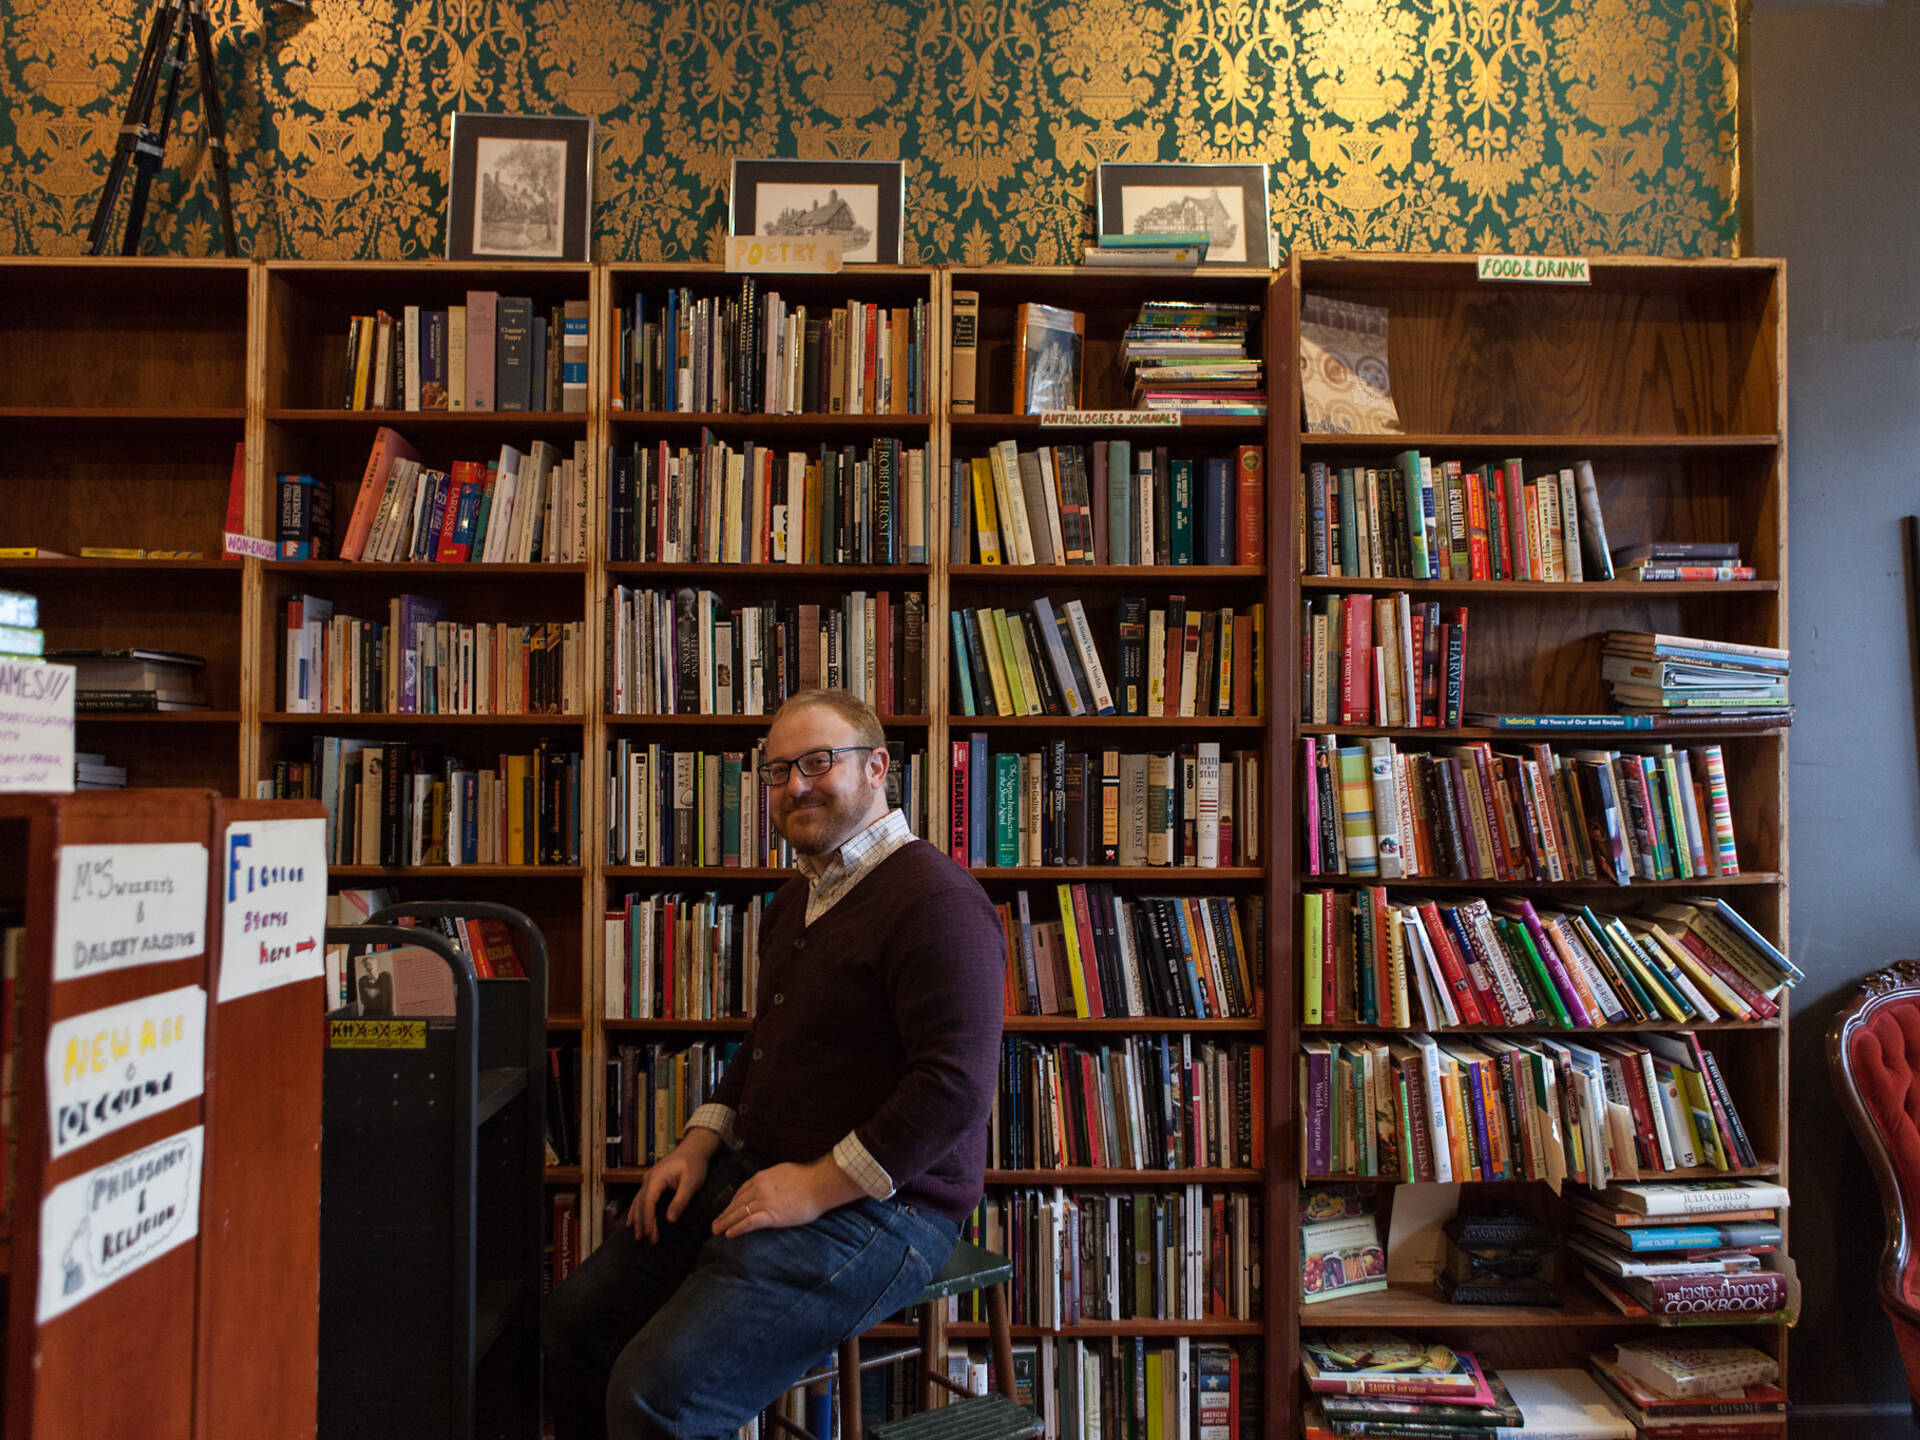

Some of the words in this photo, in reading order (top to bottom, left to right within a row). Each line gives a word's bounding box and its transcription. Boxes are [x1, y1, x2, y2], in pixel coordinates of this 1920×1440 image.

[735, 240, 816, 265] POETRY
[1481, 258, 1521, 277] FOOD
[1535, 259, 1585, 278] DRINK
[1043, 413, 1115, 425] ANTHOLOGIES
[1117, 413, 1124, 424] &
[1126, 413, 1178, 425] JOURNALS
[878, 451, 888, 496] ROBERT
[443, 487, 460, 538] LAROUSSE
[878, 499, 889, 537] FROST
[1447, 488, 1466, 539] REVOLUTION
[1567, 520, 1577, 544] RANT
[1075, 615, 1091, 644] Fiction's
[1083, 644, 1095, 664] Many
[1089, 662, 1104, 689] Worlds
[1345, 646, 1351, 656] MY
[1448, 639, 1461, 706] HARVEST
[1601, 719, 1624, 727] Recipes
[1053, 743, 1062, 774] Minding
[1200, 757, 1218, 765] STATE
[1135, 768, 1144, 793] THIS
[1200, 770, 1218, 779] STATE
[1532, 773, 1540, 783] TOP
[954, 769, 964, 827] BREAKING
[999, 787, 1007, 804] Short
[1007, 777, 1015, 800] Norton
[1135, 795, 1143, 804] IS
[1482, 787, 1491, 801] THE
[1534, 783, 1544, 800] SECRET
[1618, 779, 1628, 798] New
[999, 806, 1007, 824] Novel
[1007, 801, 1015, 839] Introduction
[1136, 806, 1144, 823] MY
[1484, 801, 1496, 825] APPLE
[1537, 800, 1550, 829] RESTAURANT
[1622, 797, 1635, 837] American
[954, 831, 963, 847] ICE
[1135, 824, 1143, 847] BEST
[1489, 825, 1503, 858] GROWER
[1543, 829, 1554, 848] RECIPES
[1629, 838, 1640, 858] Chef
[1361, 895, 1370, 939] EVERYDAY
[1161, 921, 1172, 948] HOUSE
[1179, 926, 1189, 949] HOUSE
[1214, 924, 1223, 946] HOUSE
[1224, 924, 1232, 947] HOUSE
[259, 941, 291, 965] here
[1363, 941, 1371, 968] PASTA
[1537, 932, 1556, 962] InStyle
[1396, 944, 1406, 990] KITCHEN
[62, 1029, 130, 1087] NEW
[139, 1014, 185, 1056] AGE
[1499, 1054, 1512, 1081] RAW
[1314, 1081, 1324, 1106] World
[1714, 1078, 1730, 1105] ESSENTIALS
[1312, 1108, 1323, 1150] Vegetarian
[1409, 1068, 1421, 1116] LAUREL'S
[1415, 1119, 1428, 1169] KITCHEN
[1434, 1110, 1444, 1127] FOOD
[1486, 1109, 1498, 1136] Vegan
[1490, 1136, 1502, 1163] Living
[91, 1146, 187, 1213] PHILOSOPHY
[1684, 1194, 1709, 1204] JULIA
[1712, 1192, 1750, 1203] CHILD'S
[101, 1204, 176, 1264] RELIGION
[1654, 1239, 1675, 1247] OLIVER
[1666, 1292, 1681, 1302] THE
[1680, 1285, 1711, 1298] taste
[1728, 1281, 1769, 1297] home
[1664, 1296, 1769, 1314] COOKBOOK
[1368, 1383, 1396, 1394] SAUCES
[1710, 1403, 1760, 1414] CUISINE
